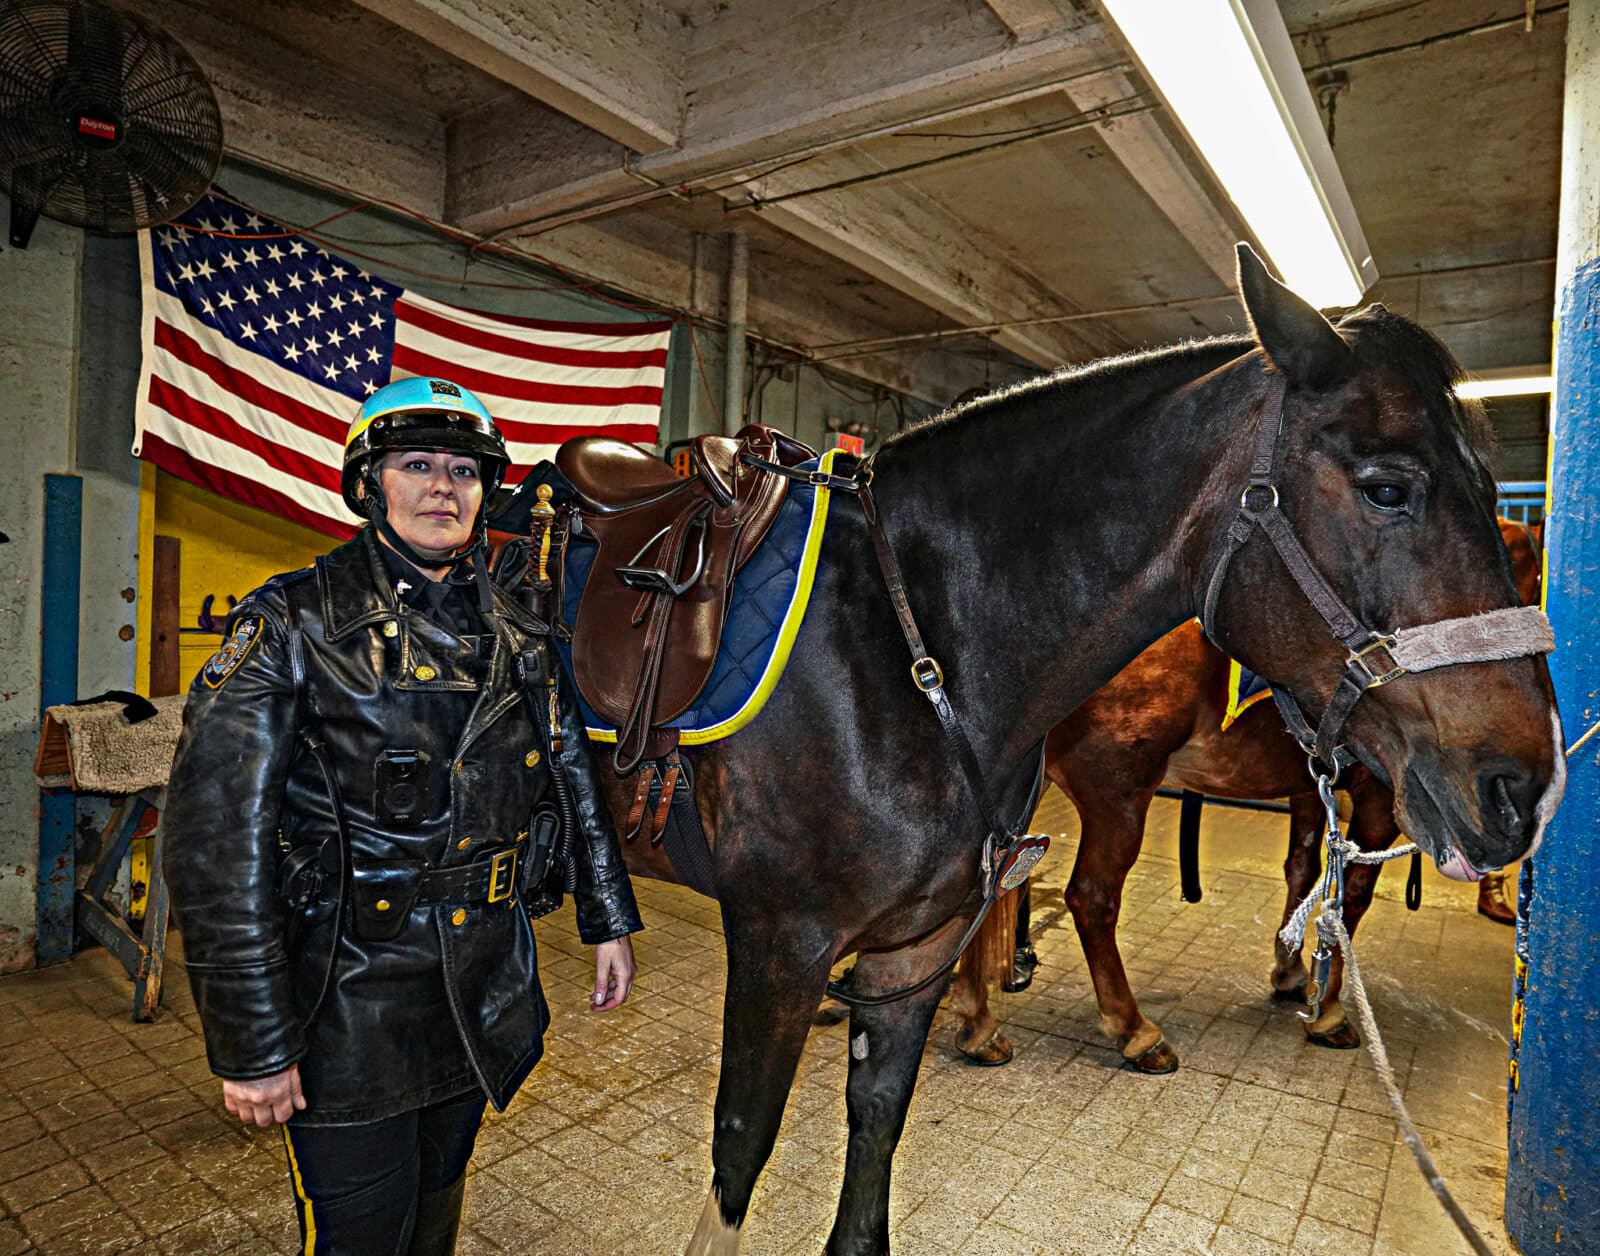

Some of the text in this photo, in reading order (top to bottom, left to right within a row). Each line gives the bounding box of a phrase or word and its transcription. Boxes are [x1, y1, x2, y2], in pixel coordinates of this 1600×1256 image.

[80, 117, 115, 132] Dayton
[222, 660, 237, 676] NEW
[235, 640, 252, 659] YORK
